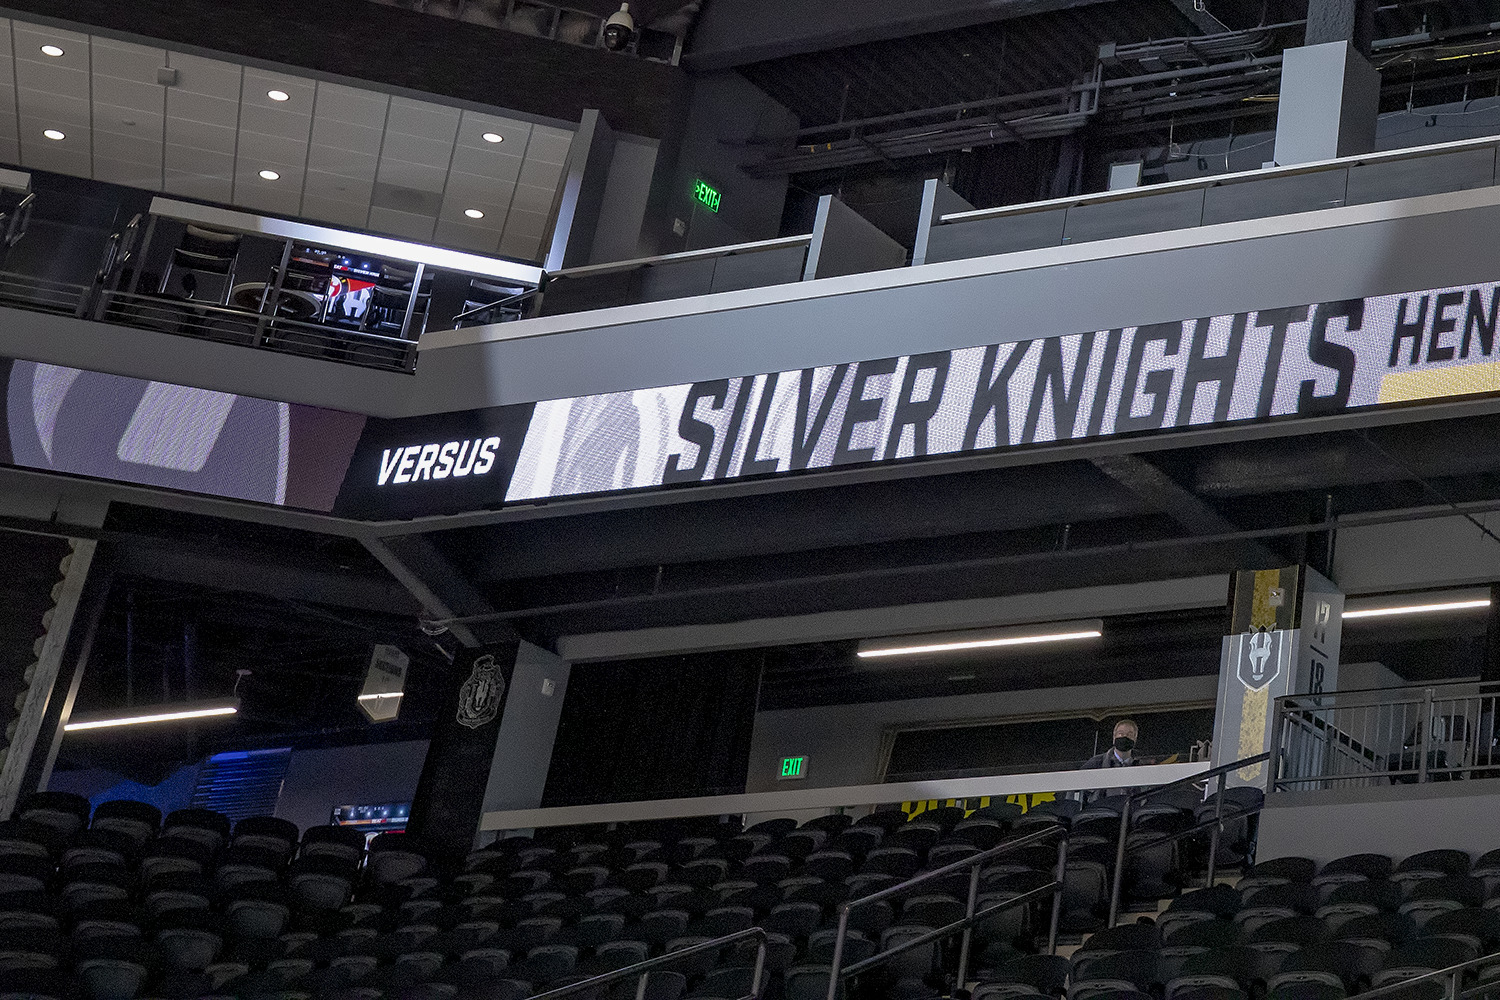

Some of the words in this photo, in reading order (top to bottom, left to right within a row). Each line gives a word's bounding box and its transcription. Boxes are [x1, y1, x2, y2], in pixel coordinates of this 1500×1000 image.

[698, 183, 717, 208] EXIT
[664, 349, 953, 483] SILVER
[963, 297, 1365, 450] KNIGHTS
[377, 436, 500, 486] VERSUS
[1308, 658, 1325, 707] 18
[781, 757, 804, 777] EXIT
